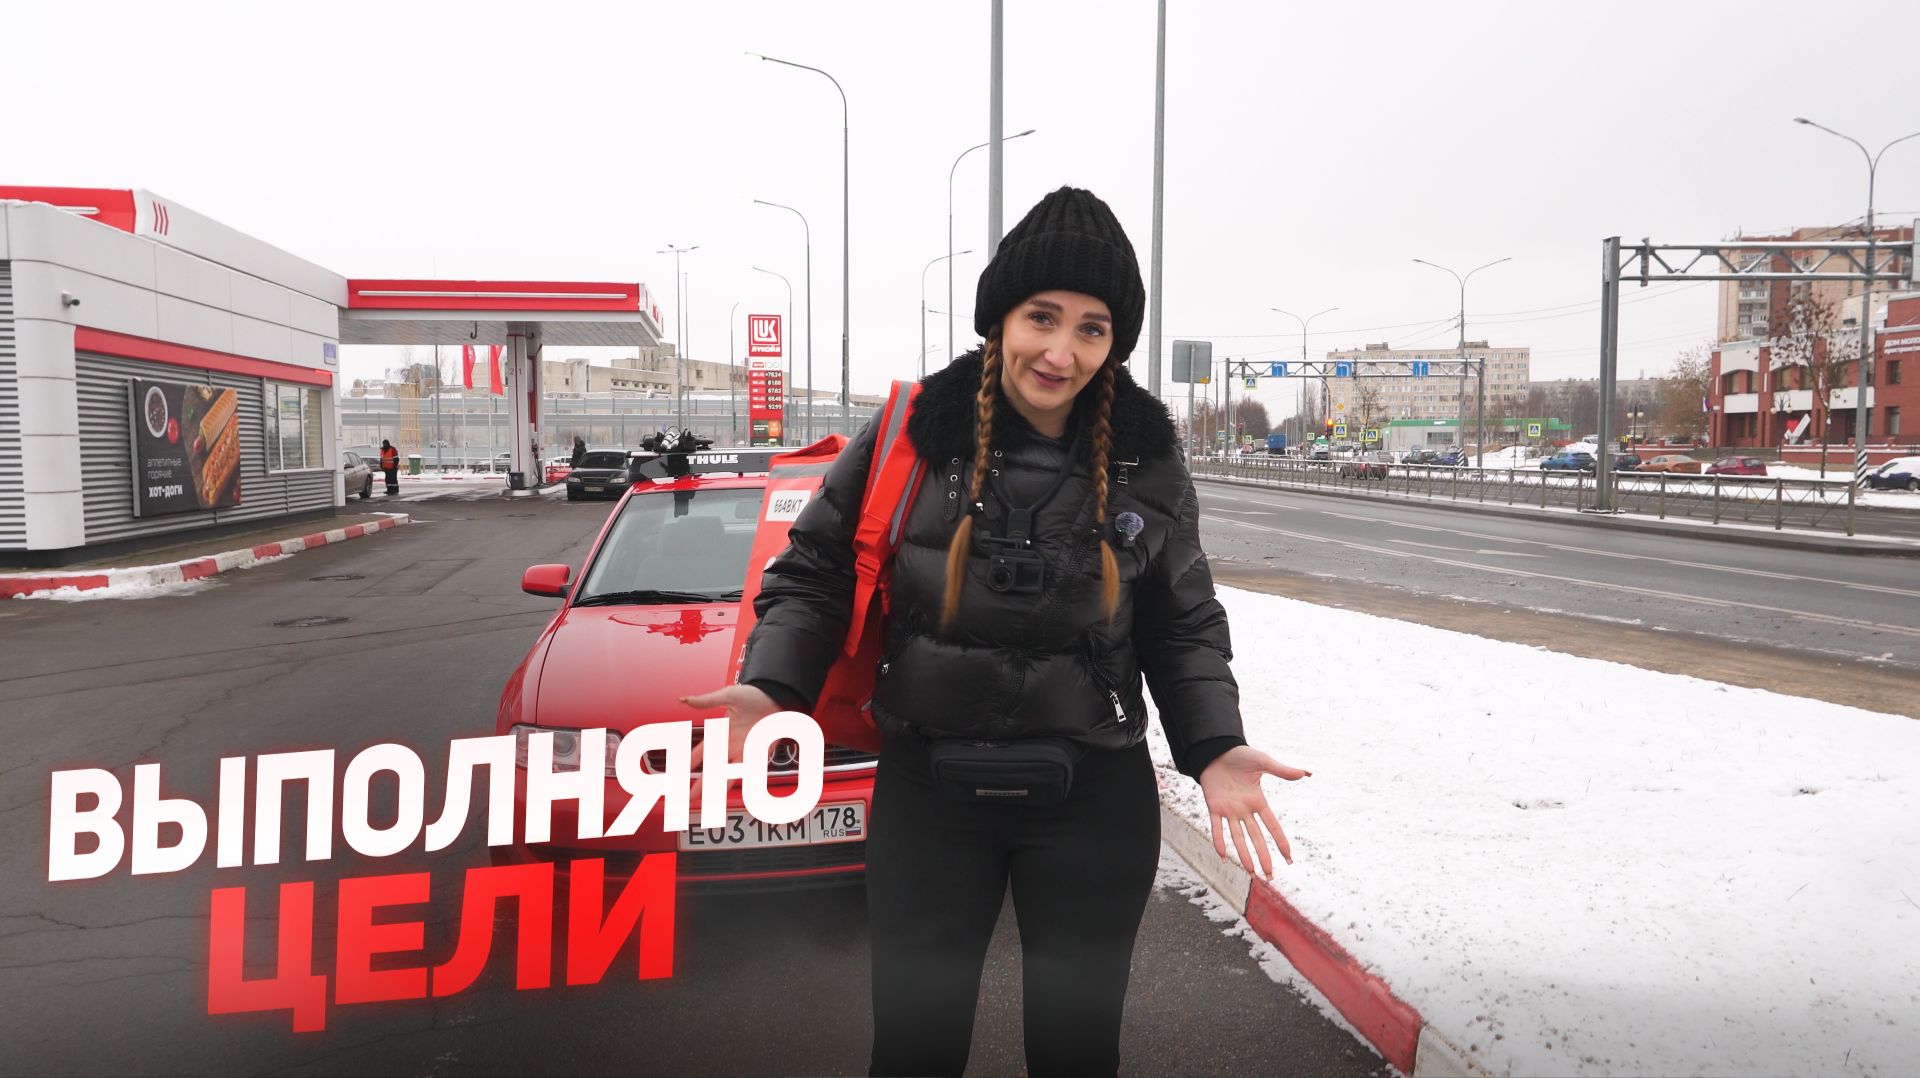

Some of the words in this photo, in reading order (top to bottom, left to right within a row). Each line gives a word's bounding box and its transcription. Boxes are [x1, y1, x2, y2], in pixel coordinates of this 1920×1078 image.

[686, 454, 739, 465] THULE
[813, 806, 856, 830] 178
[823, 827, 845, 838] RUS
